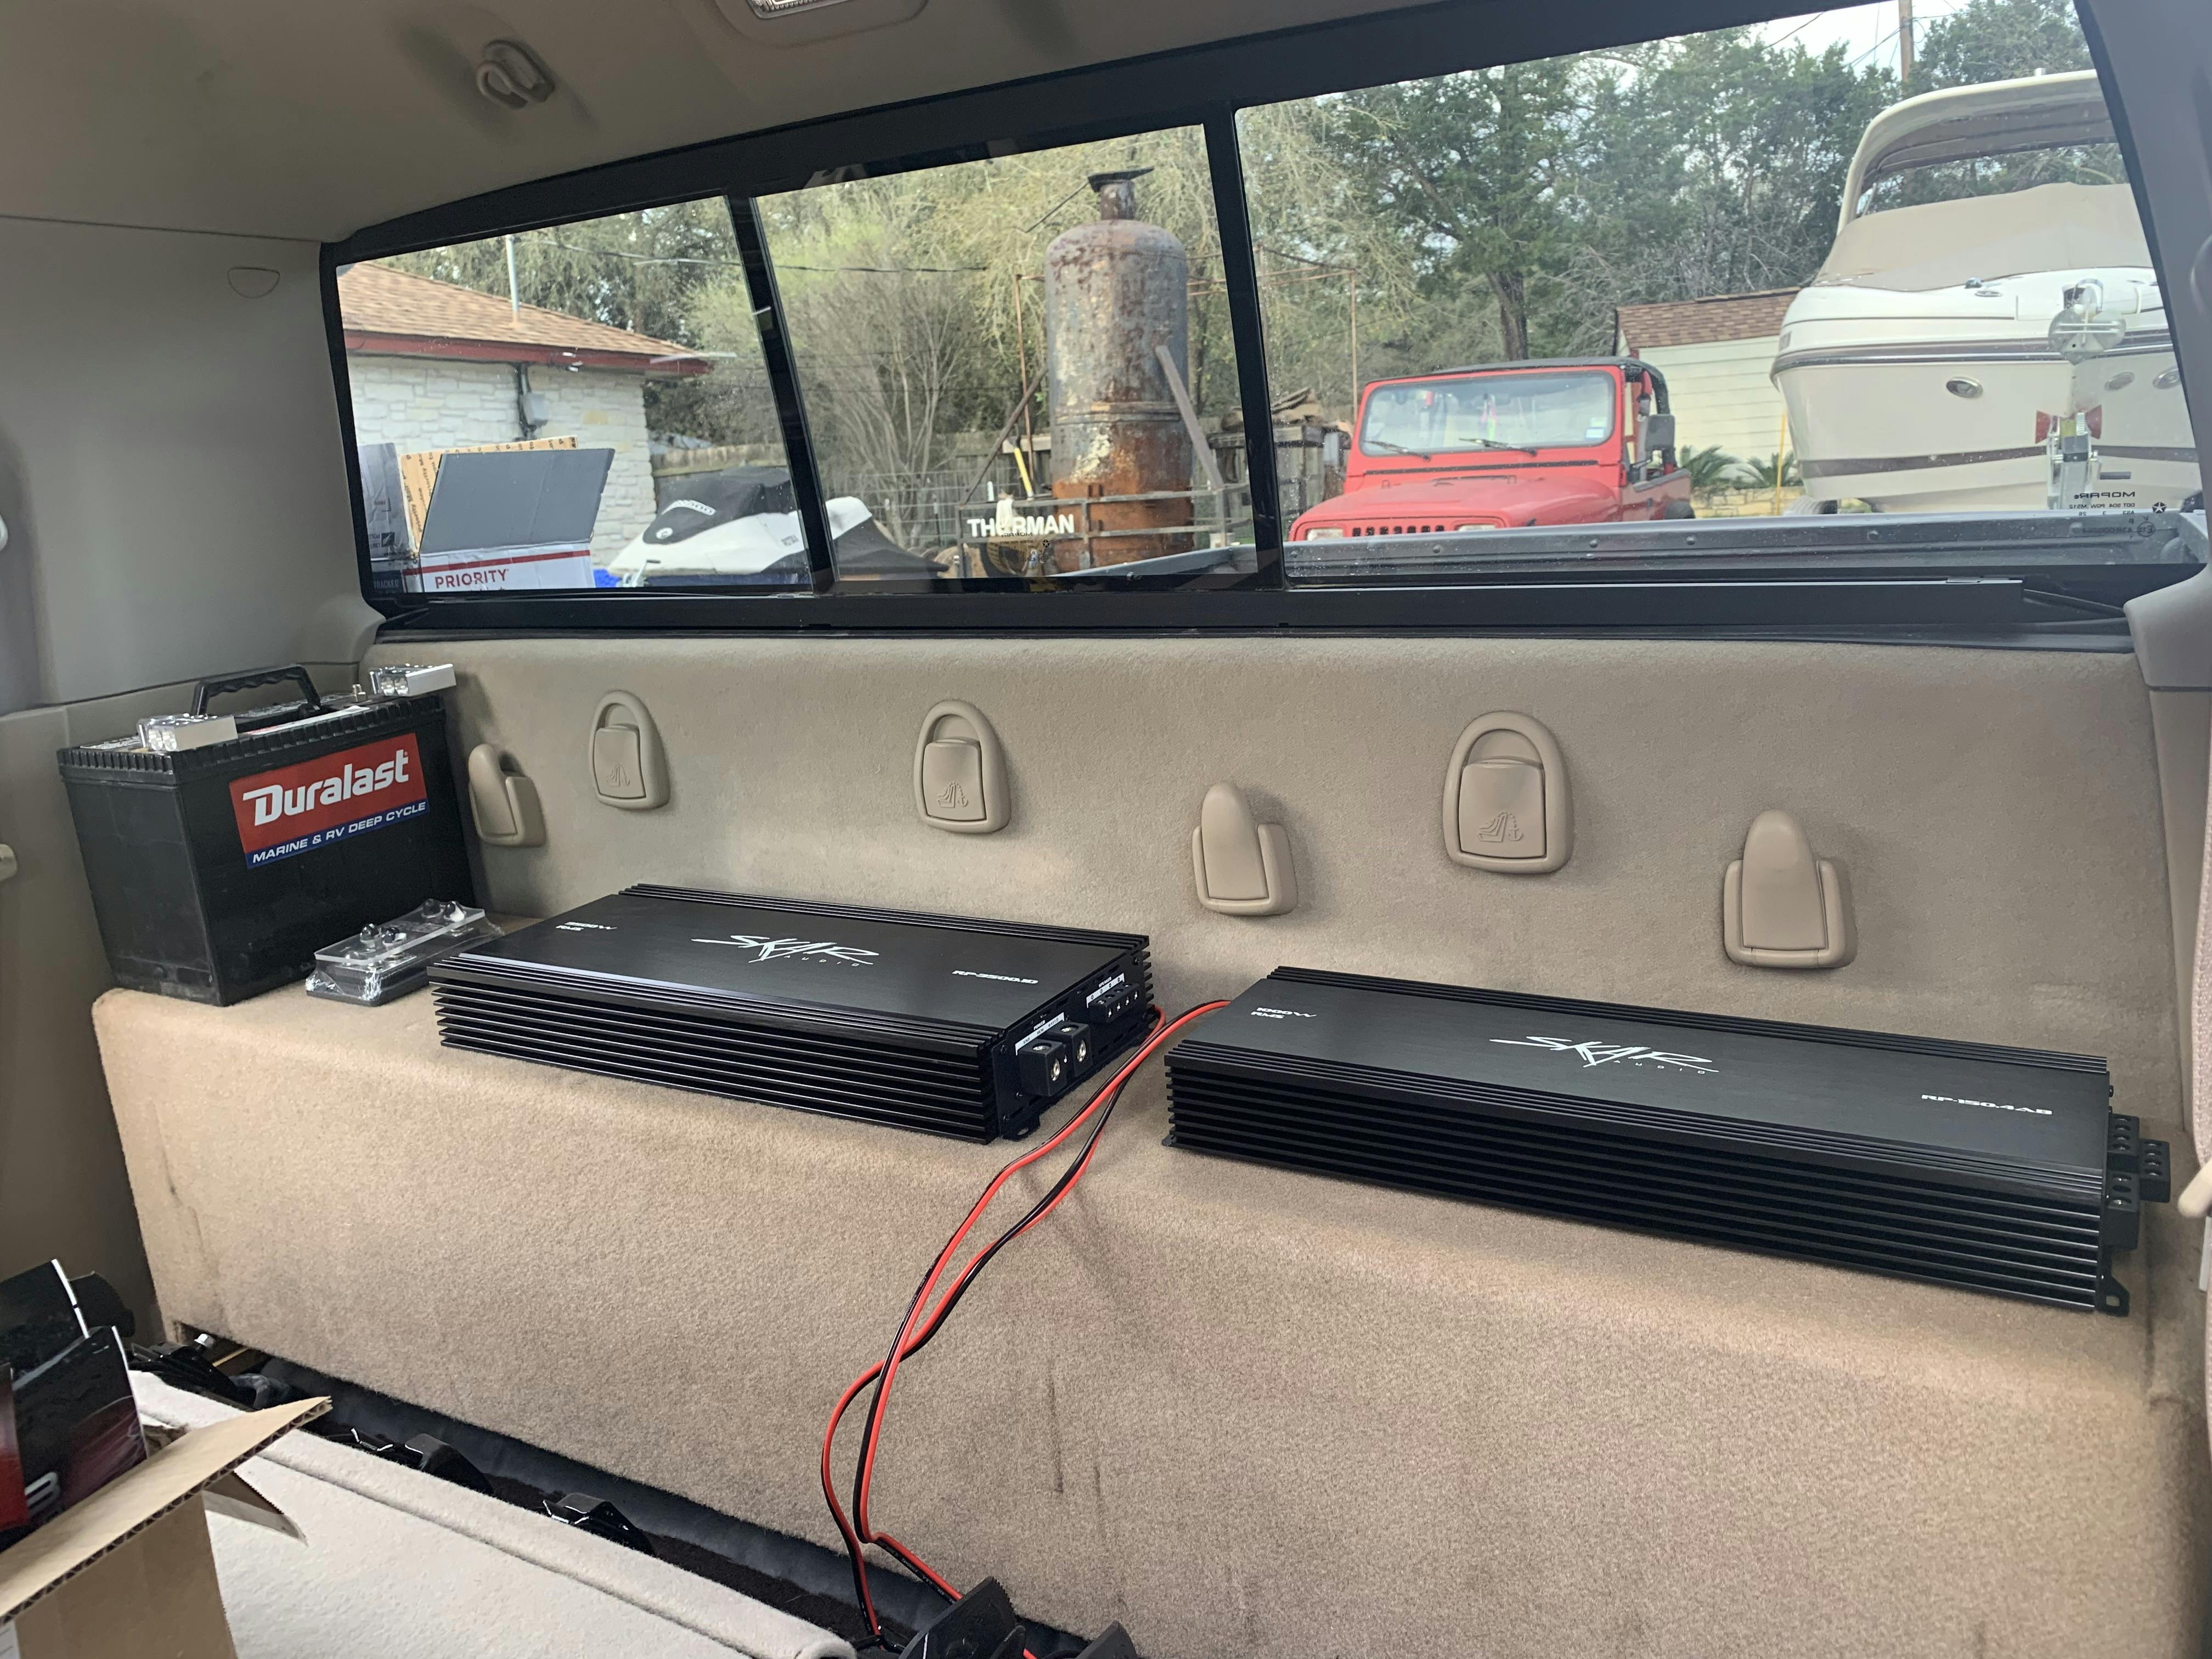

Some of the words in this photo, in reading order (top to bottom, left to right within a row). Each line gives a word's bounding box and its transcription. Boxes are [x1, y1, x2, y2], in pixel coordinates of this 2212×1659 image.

[967, 514, 1075, 537] THRMAN
[435, 569, 507, 589] PRIORITY
[243, 749, 409, 826] Duralast
[252, 838, 308, 864] MARINE
[312, 834, 321, 844] &
[326, 827, 345, 840] RV
[348, 815, 382, 833] DEEP
[386, 802, 426, 821] CYCLE
[783, 955, 860, 967] AUDIO
[1613, 1060, 1706, 1074] AUDIO
